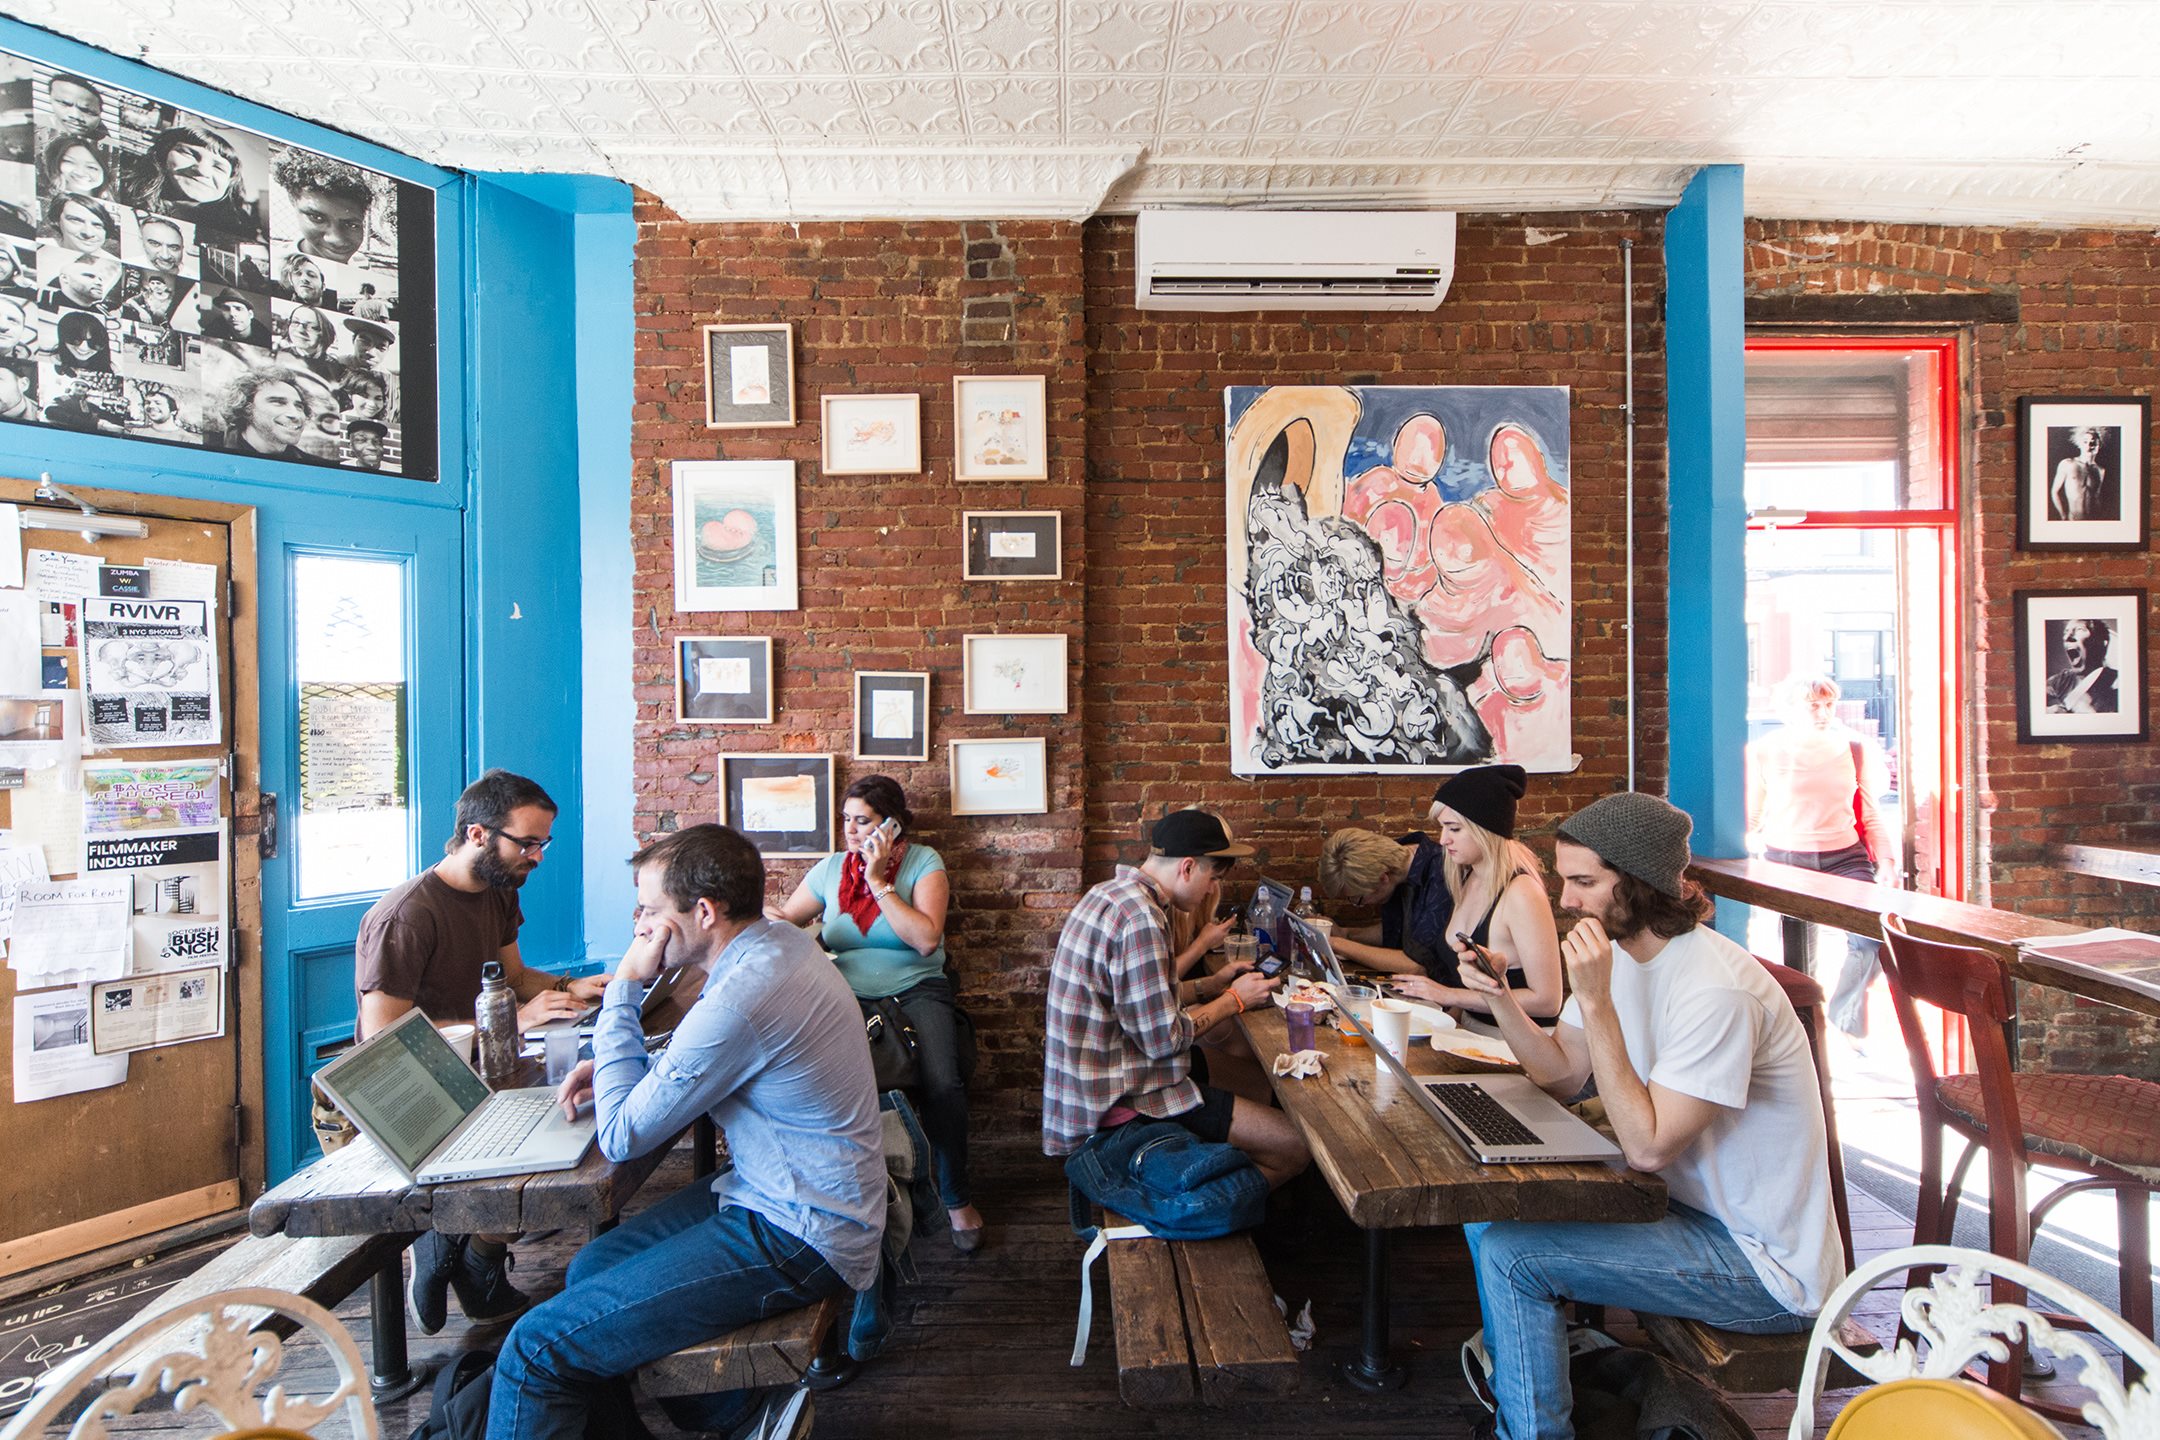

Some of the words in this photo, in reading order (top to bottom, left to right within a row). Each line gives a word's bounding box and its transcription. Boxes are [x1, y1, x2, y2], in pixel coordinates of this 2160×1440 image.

[110, 569, 140, 577] ZUMBA
[119, 577, 132, 585] W/
[110, 602, 180, 620] RVIVR
[89, 840, 177, 856] FILMMAKER
[89, 854, 163, 869] INDUSTRY
[20, 890, 63, 902] ROOM
[172, 926, 206, 935] OCTOBER
[173, 931, 219, 946] BUSH
[169, 941, 219, 957] WICK
[33, 1304, 64, 1321] all
